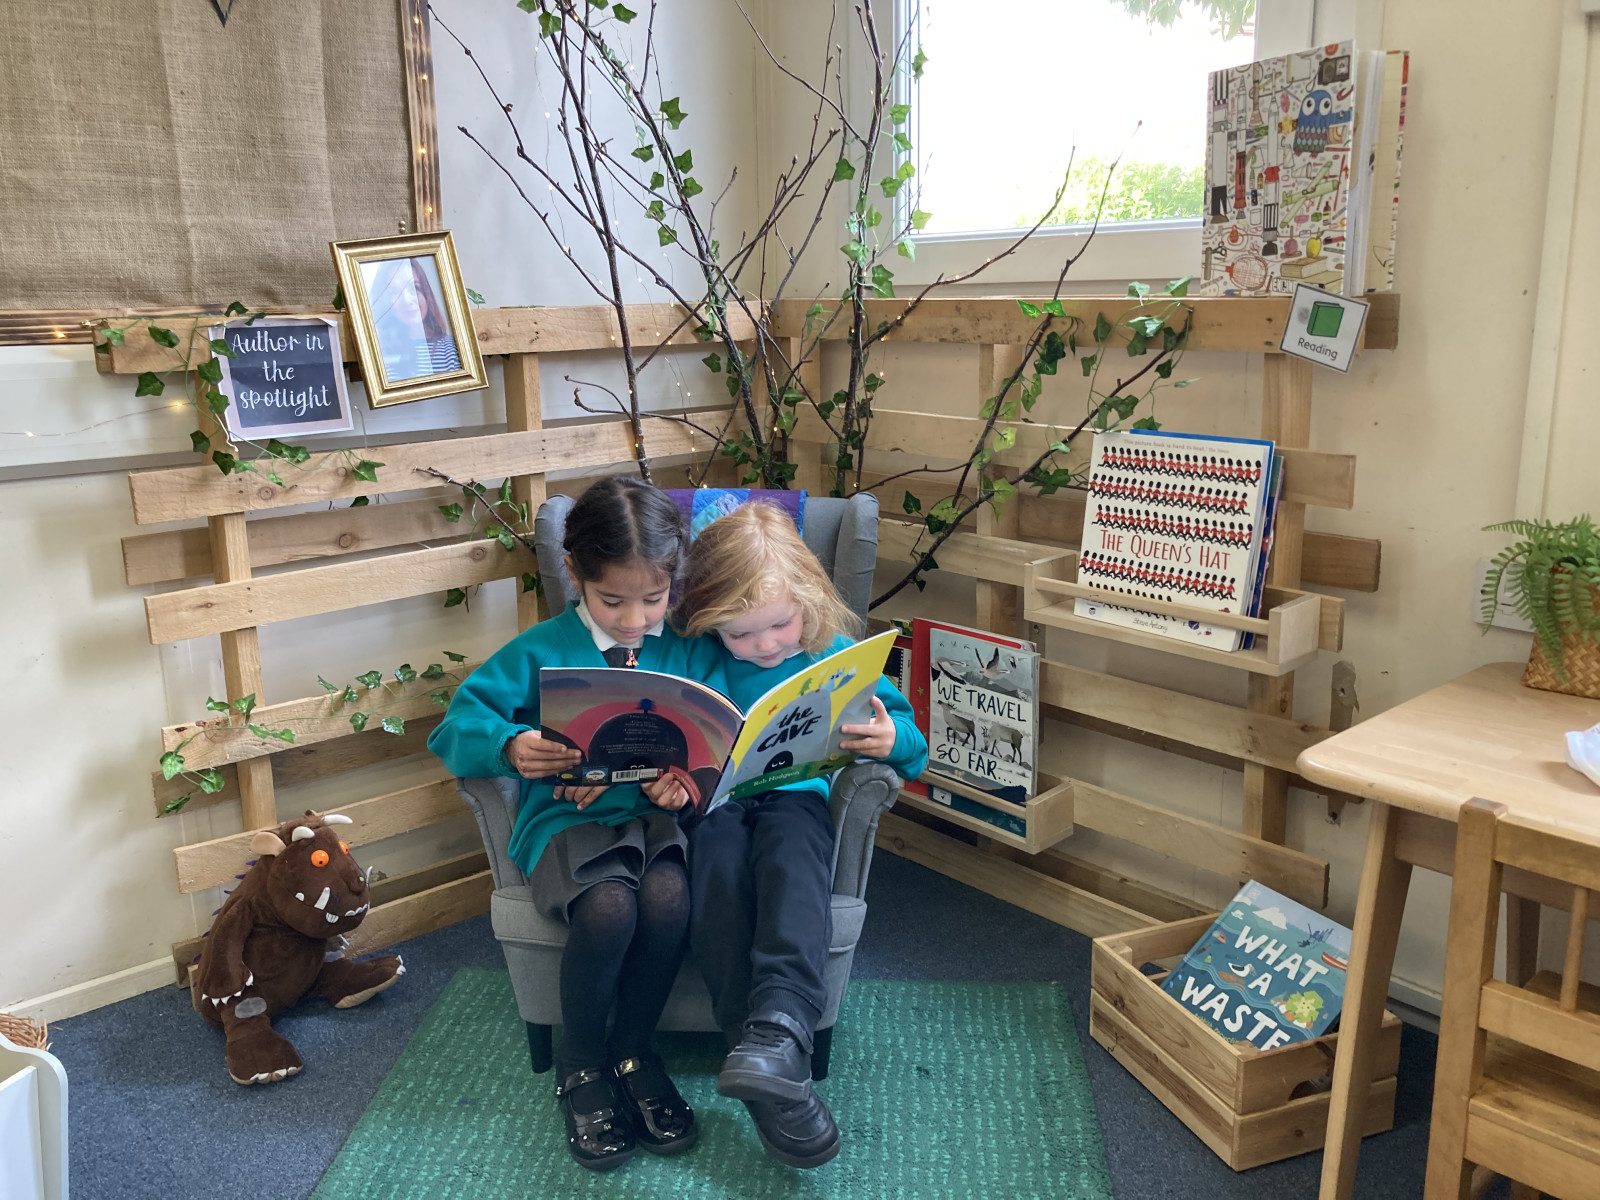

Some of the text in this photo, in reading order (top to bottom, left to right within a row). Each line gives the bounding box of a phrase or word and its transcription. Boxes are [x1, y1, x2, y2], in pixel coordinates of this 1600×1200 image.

[232, 331, 325, 354] Author in
[1297, 337, 1338, 361] Reading
[262, 360, 295, 382] the
[240, 385, 332, 417] spotlight
[1100, 529, 1231, 571] THE QUEEN'S HAT
[937, 678, 1027, 723] WE TRAVEL
[776, 706, 814, 730] the
[756, 714, 822, 752] CAVE
[936, 743, 961, 764] SO
[1234, 924, 1329, 987] WHAT
[1247, 972, 1273, 996] A
